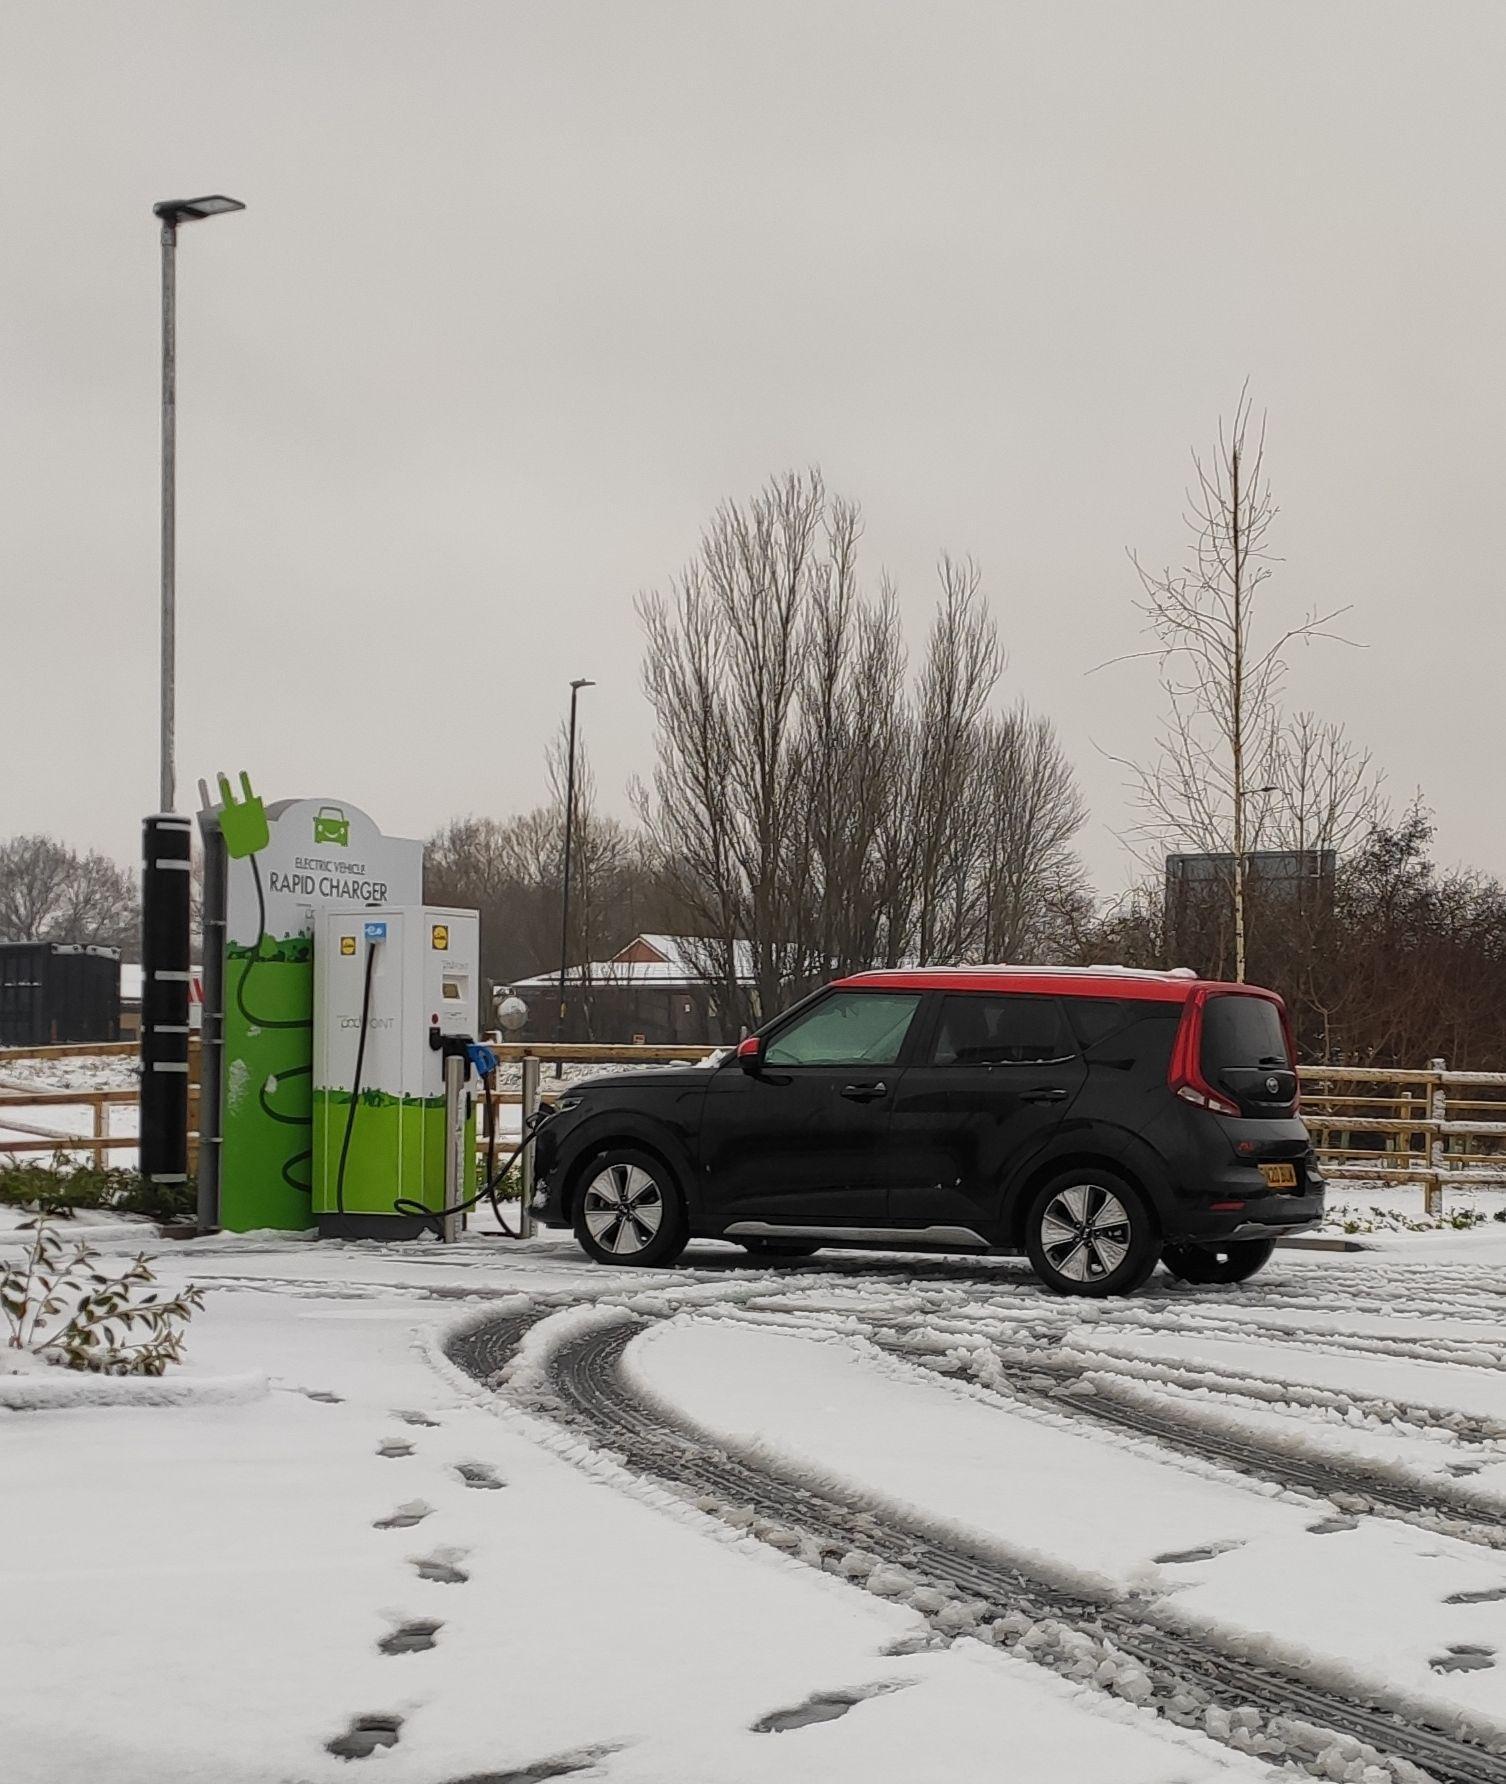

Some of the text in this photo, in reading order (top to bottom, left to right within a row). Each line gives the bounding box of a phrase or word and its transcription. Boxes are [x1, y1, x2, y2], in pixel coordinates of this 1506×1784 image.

[295, 857, 366, 875] ELECTRIC VEHICLE
[270, 871, 388, 901] RAPID CHARGER
